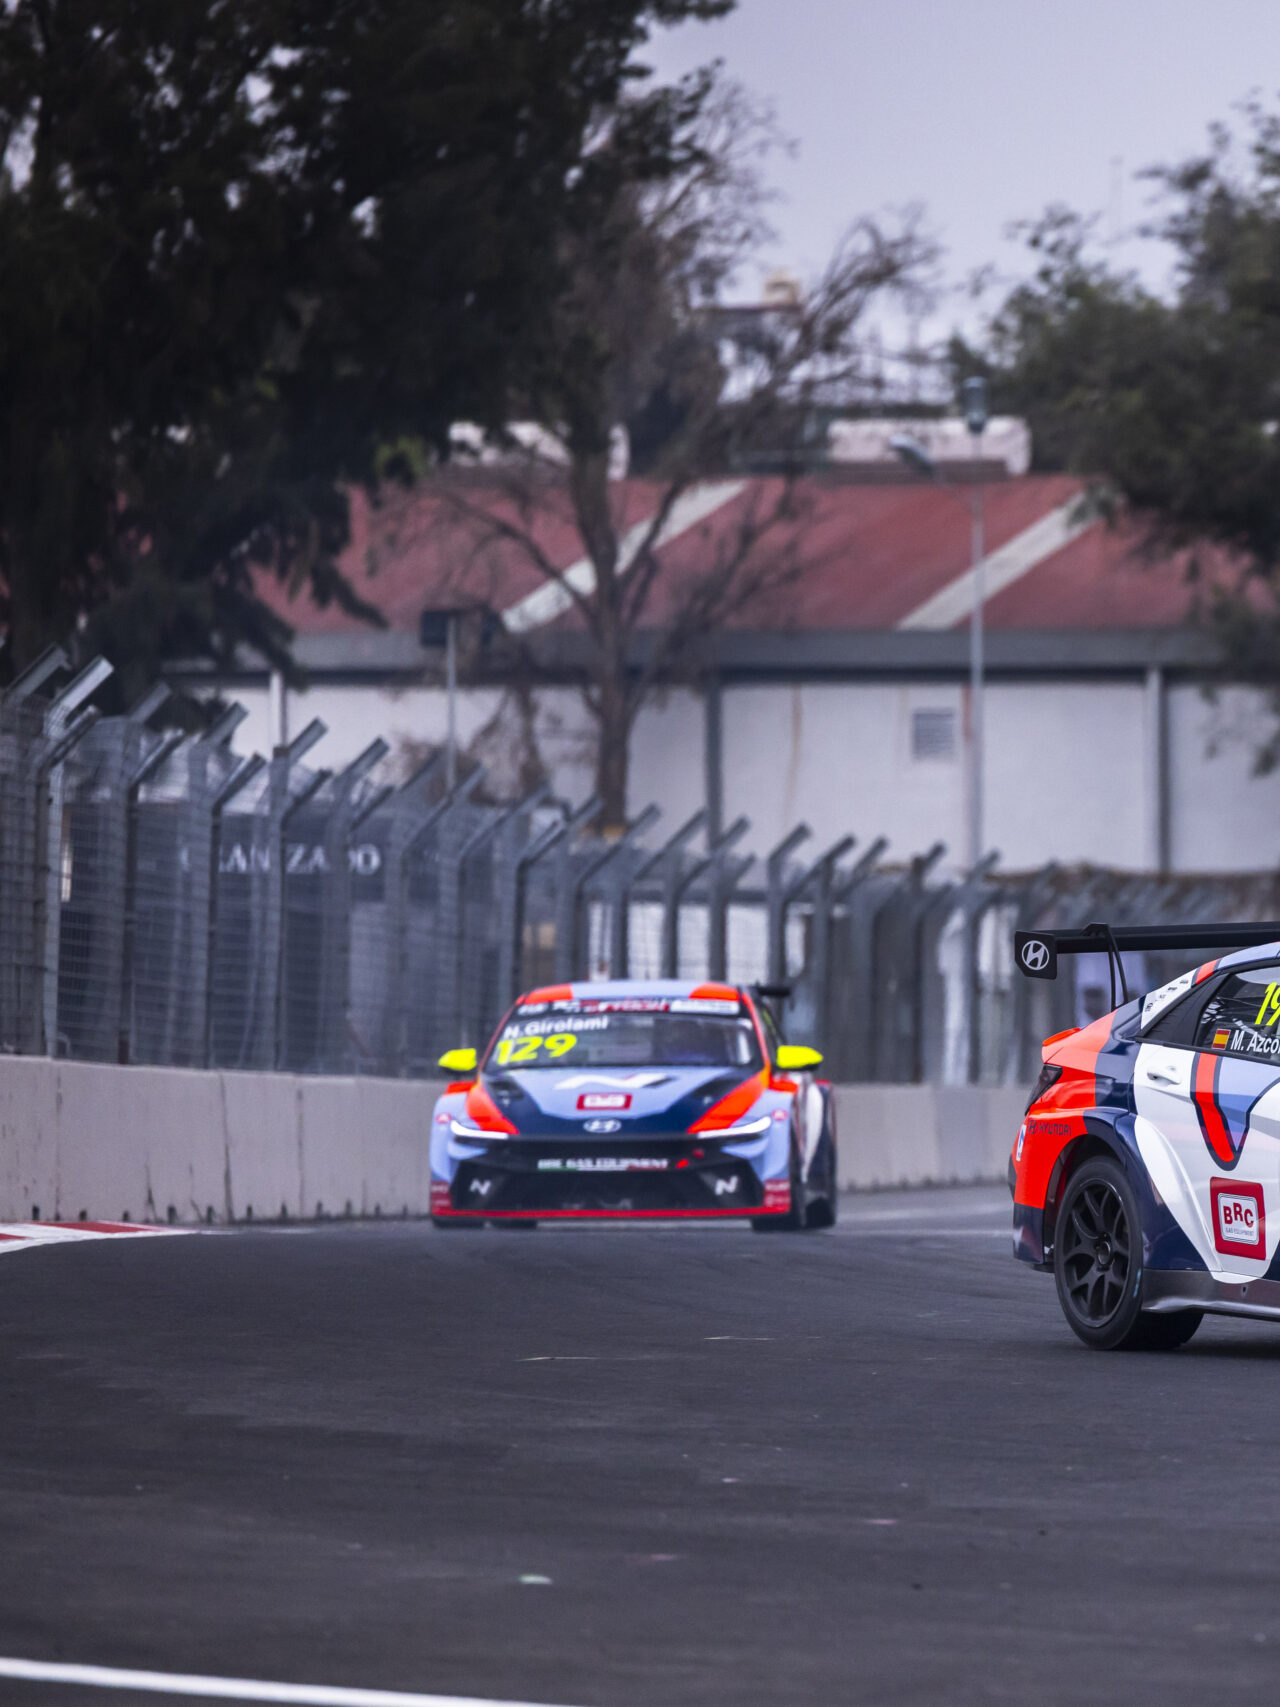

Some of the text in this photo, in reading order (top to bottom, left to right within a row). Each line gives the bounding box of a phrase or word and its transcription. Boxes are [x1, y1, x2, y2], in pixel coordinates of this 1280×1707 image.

[497, 1033, 577, 1065] 129
[1230, 1029, 1244, 1051] M.
[1039, 1123, 1072, 1136] HYUNDAI
[1223, 1202, 1254, 1228] BRC
